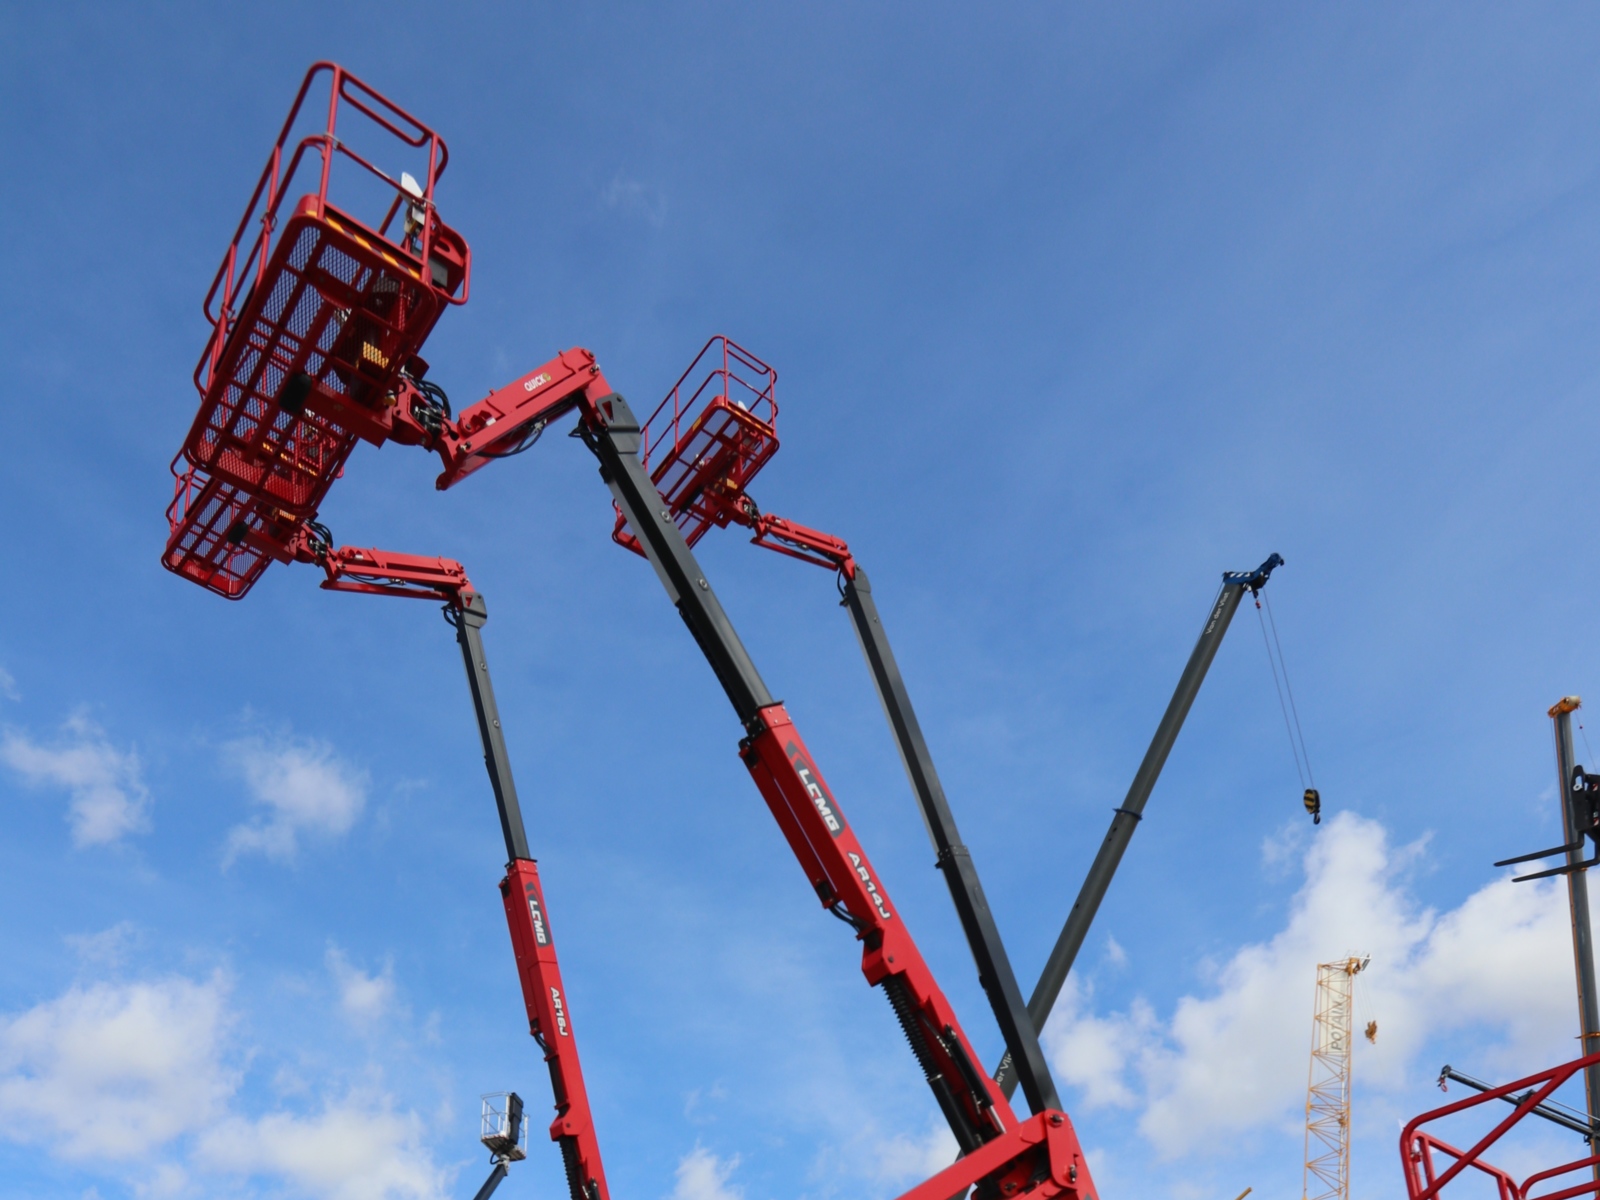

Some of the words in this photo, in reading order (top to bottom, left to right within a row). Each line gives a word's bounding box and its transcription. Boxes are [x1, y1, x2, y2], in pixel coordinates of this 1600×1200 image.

[524, 373, 546, 392] QUICK
[848, 852, 891, 920] AR14J
[550, 987, 568, 1036] AR16J
